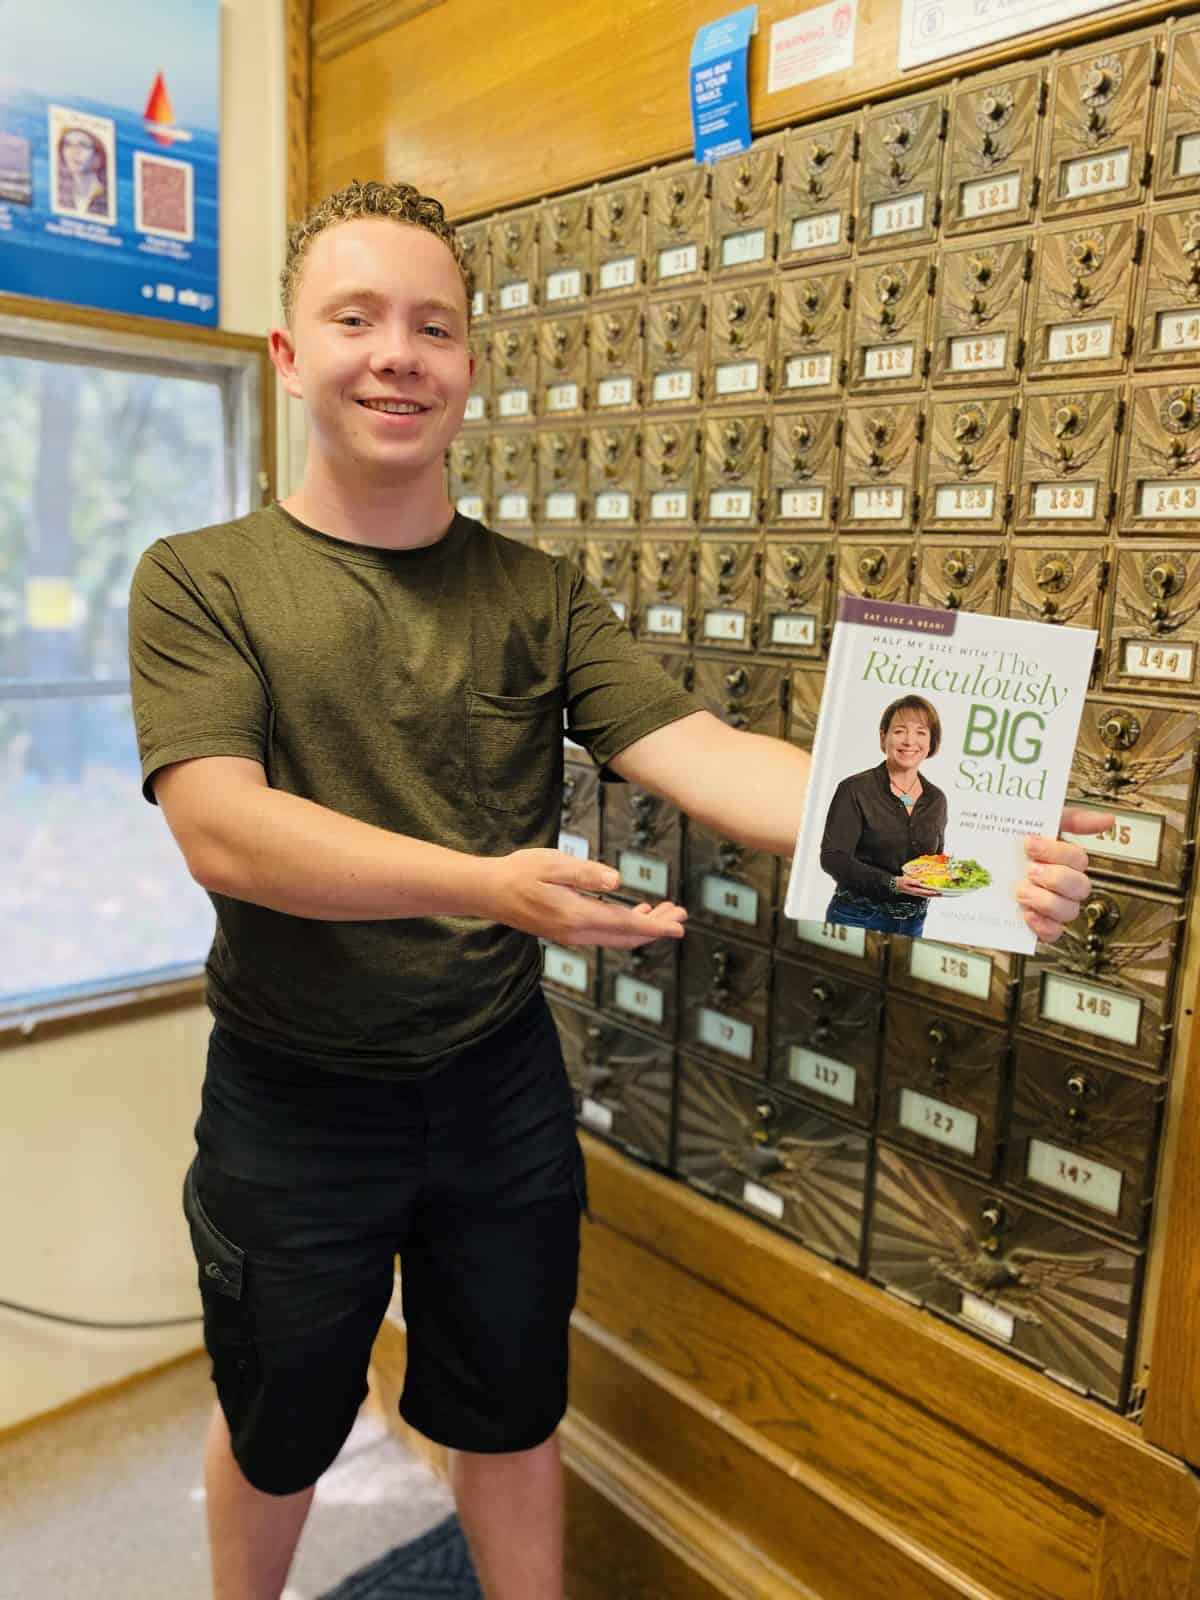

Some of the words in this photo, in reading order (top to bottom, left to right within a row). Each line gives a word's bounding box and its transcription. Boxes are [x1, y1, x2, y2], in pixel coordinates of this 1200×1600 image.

[1080, 160, 1116, 187] 131
[977, 183, 1009, 210] 121
[886, 206, 915, 229] 111
[1065, 329, 1102, 355] 132
[877, 352, 905, 371] 112
[792, 496, 817, 512] 13
[955, 489, 986, 509] 123
[1051, 488, 1085, 510] 133
[1156, 488, 1197, 512] 143
[864, 612, 881, 621] EAT
[884, 616, 905, 625] LIKE
[908, 618, 914, 626] A
[873, 636, 901, 646] HALF
[906, 640, 924, 649] MY
[929, 643, 954, 654] SIZE
[960, 647, 988, 657] WITH
[993, 651, 1039, 677] The
[1139, 647, 1179, 673] 144
[861, 651, 1069, 715] Ridiculously
[962, 703, 1046, 765] BIG
[955, 759, 1048, 801] Salad
[813, 1063, 840, 1087] 117
[1058, 1160, 1093, 1185] 147
